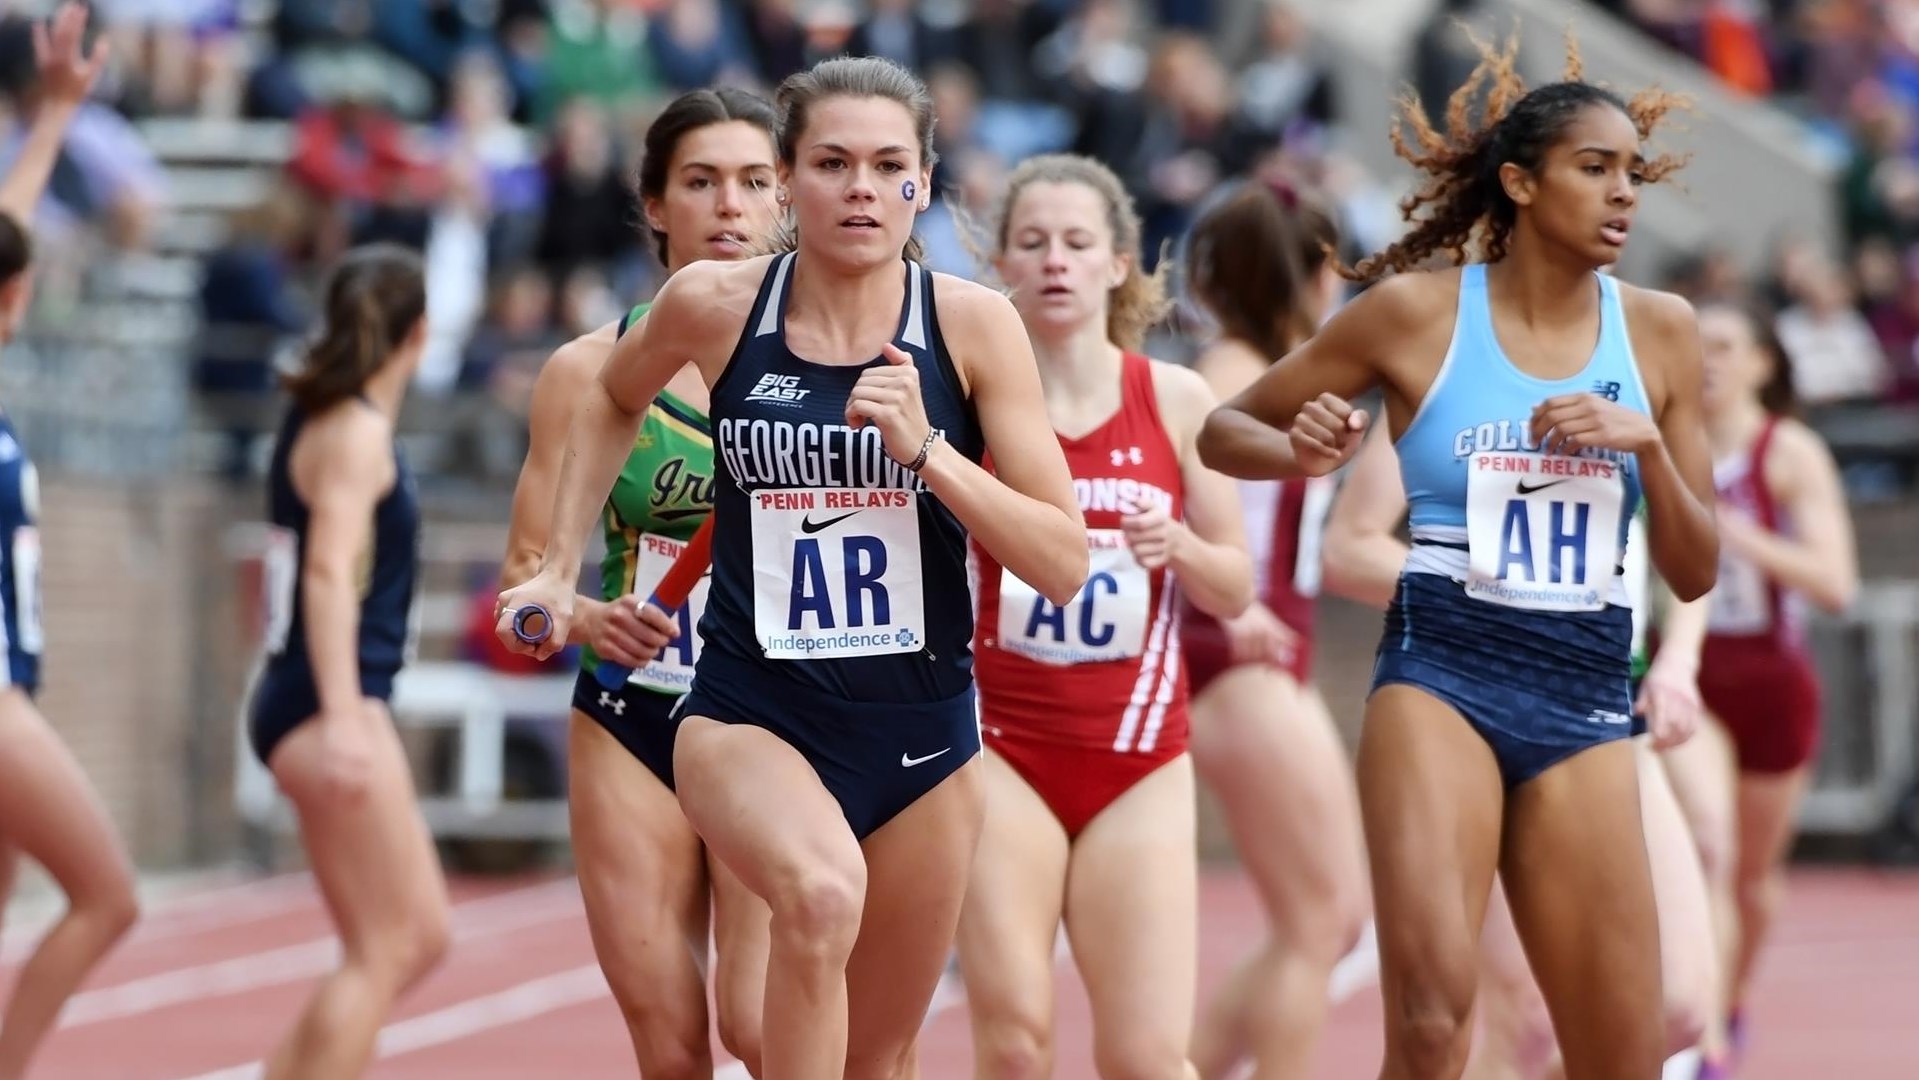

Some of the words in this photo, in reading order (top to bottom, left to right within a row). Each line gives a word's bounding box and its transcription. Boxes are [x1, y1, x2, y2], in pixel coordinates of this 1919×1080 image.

[901, 180, 915, 201] G
[758, 373, 801, 388] BIG
[749, 384, 811, 400] EAST
[719, 418, 946, 494] GEORGETO
[1453, 420, 1630, 476] COLU
[1479, 456, 1530, 474] PENN
[1540, 459, 1613, 479] RELAYS
[760, 492, 815, 510] PENN
[825, 491, 908, 508] RELAYS
[1496, 499, 1589, 584] AH
[787, 536, 890, 630] AR
[1473, 580, 1582, 602] Independence
[1026, 571, 1118, 647] AC
[768, 632, 890, 653] Independence
